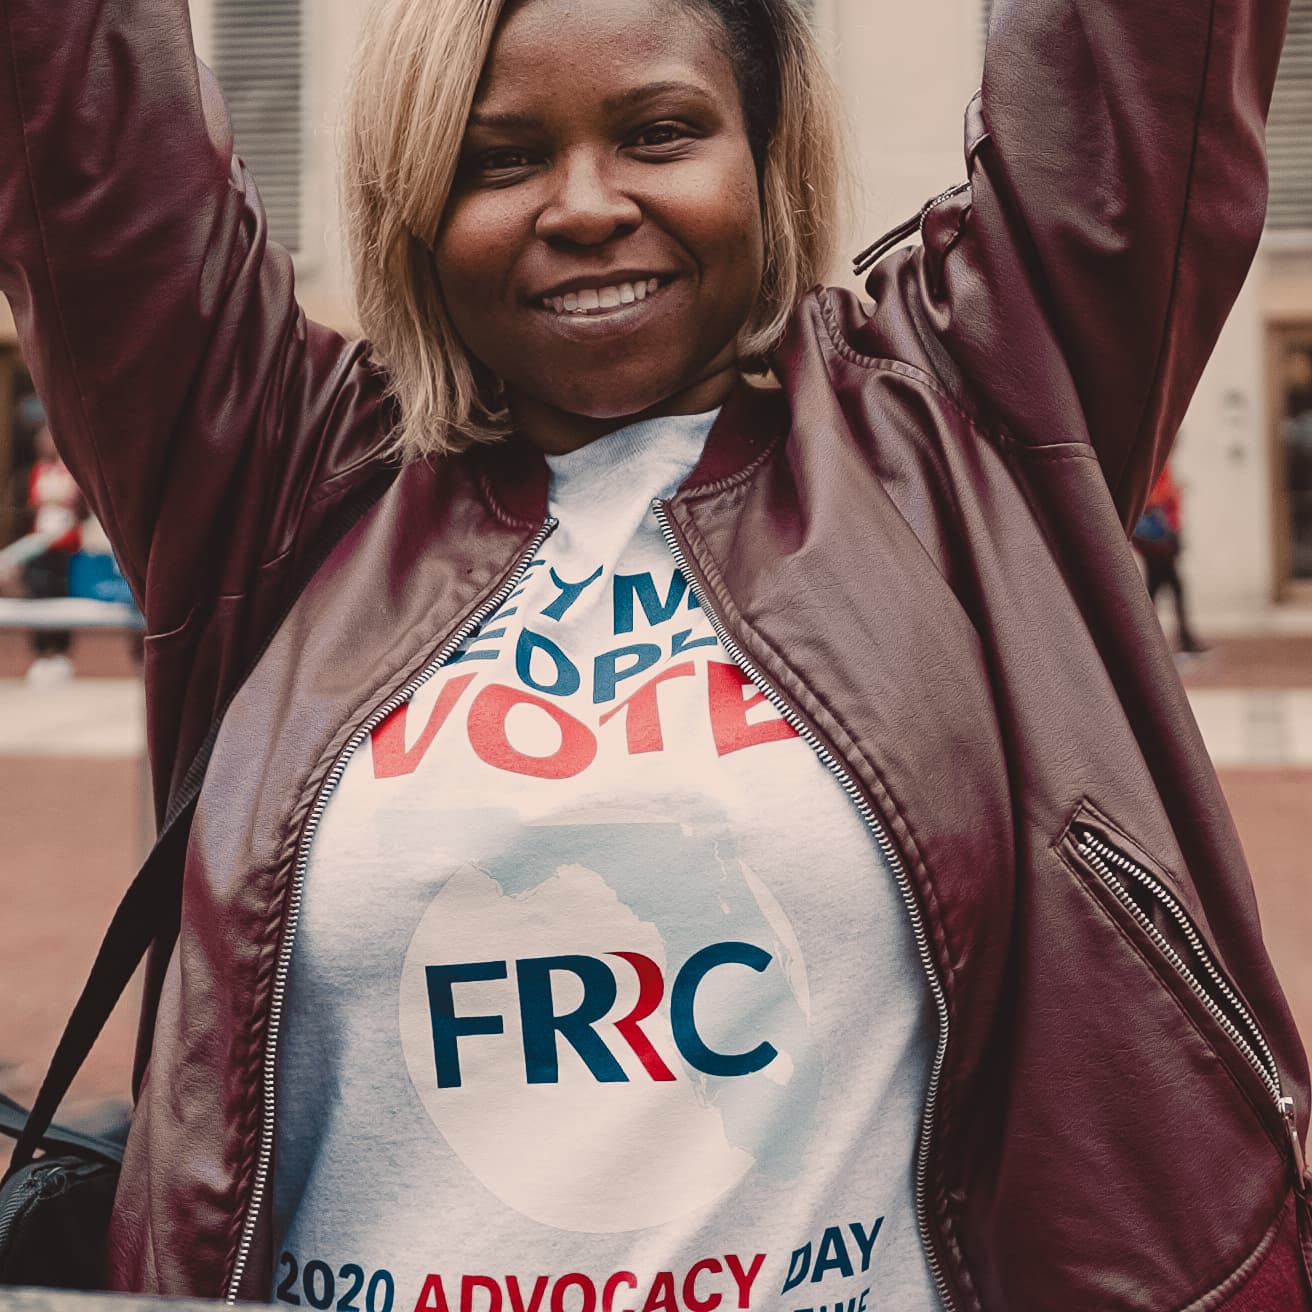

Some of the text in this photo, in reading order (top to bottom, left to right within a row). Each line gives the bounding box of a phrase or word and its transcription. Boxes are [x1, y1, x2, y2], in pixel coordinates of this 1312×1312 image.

[370, 660, 801, 780] VOTE
[424, 940, 779, 1089] FRRC
[276, 1251, 395, 1312] 2020
[413, 1253, 767, 1312] ADVOCACY
[780, 1215, 885, 1296] DAY
